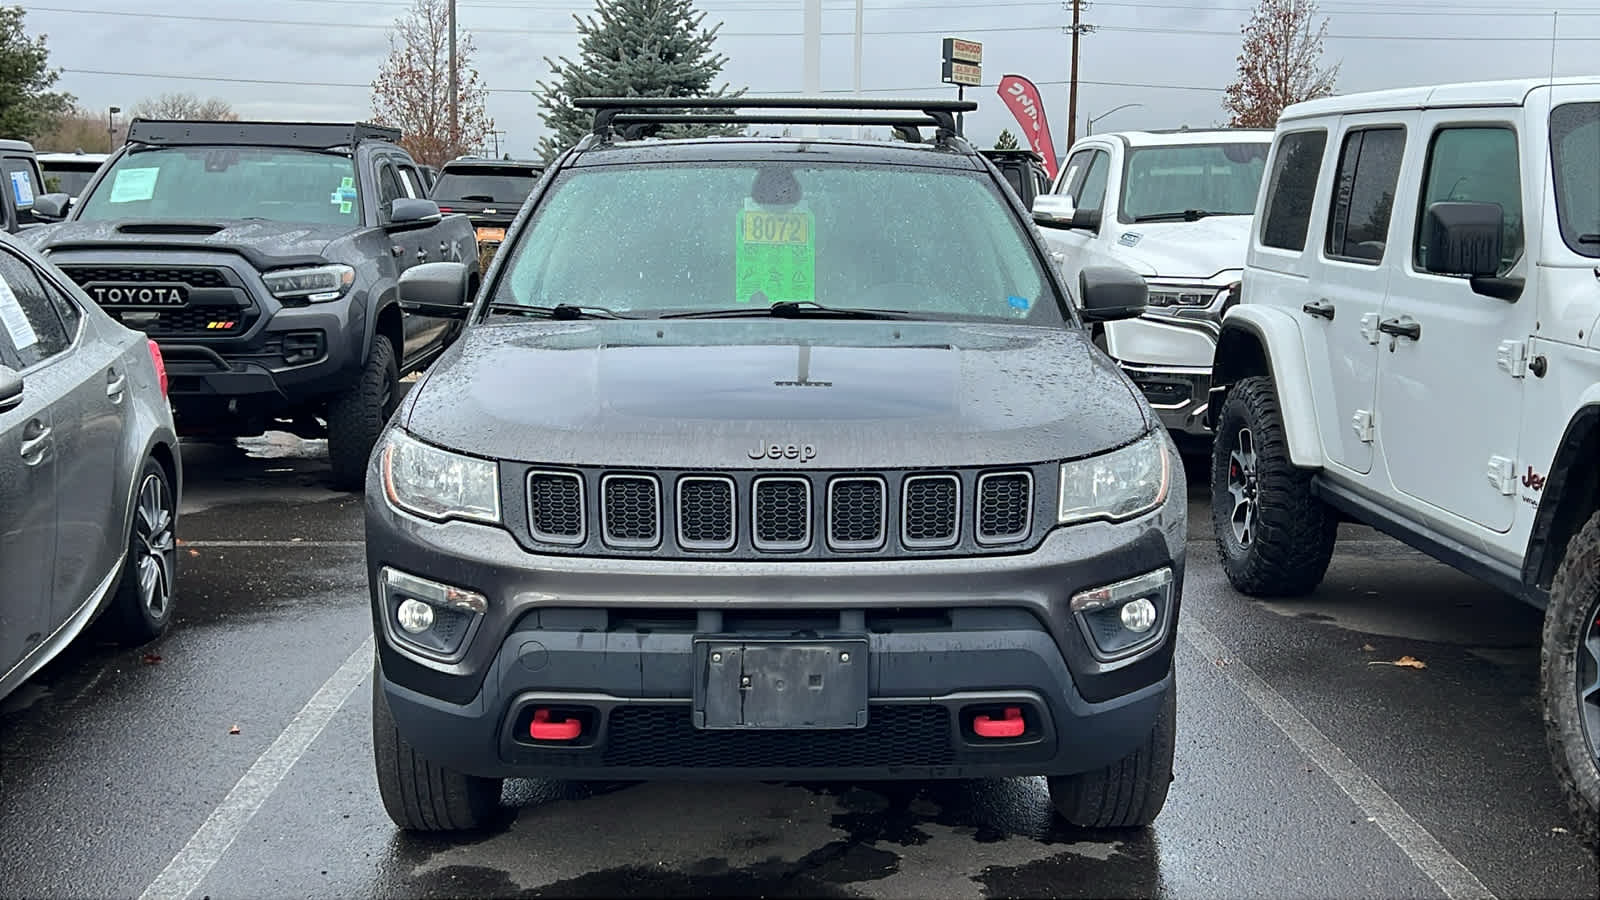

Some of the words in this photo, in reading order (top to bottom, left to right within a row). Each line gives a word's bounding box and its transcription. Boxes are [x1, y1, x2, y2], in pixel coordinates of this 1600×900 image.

[752, 215, 801, 240] 8072
[94, 288, 182, 303] TOYOTA
[747, 439, 817, 463] Jeep
